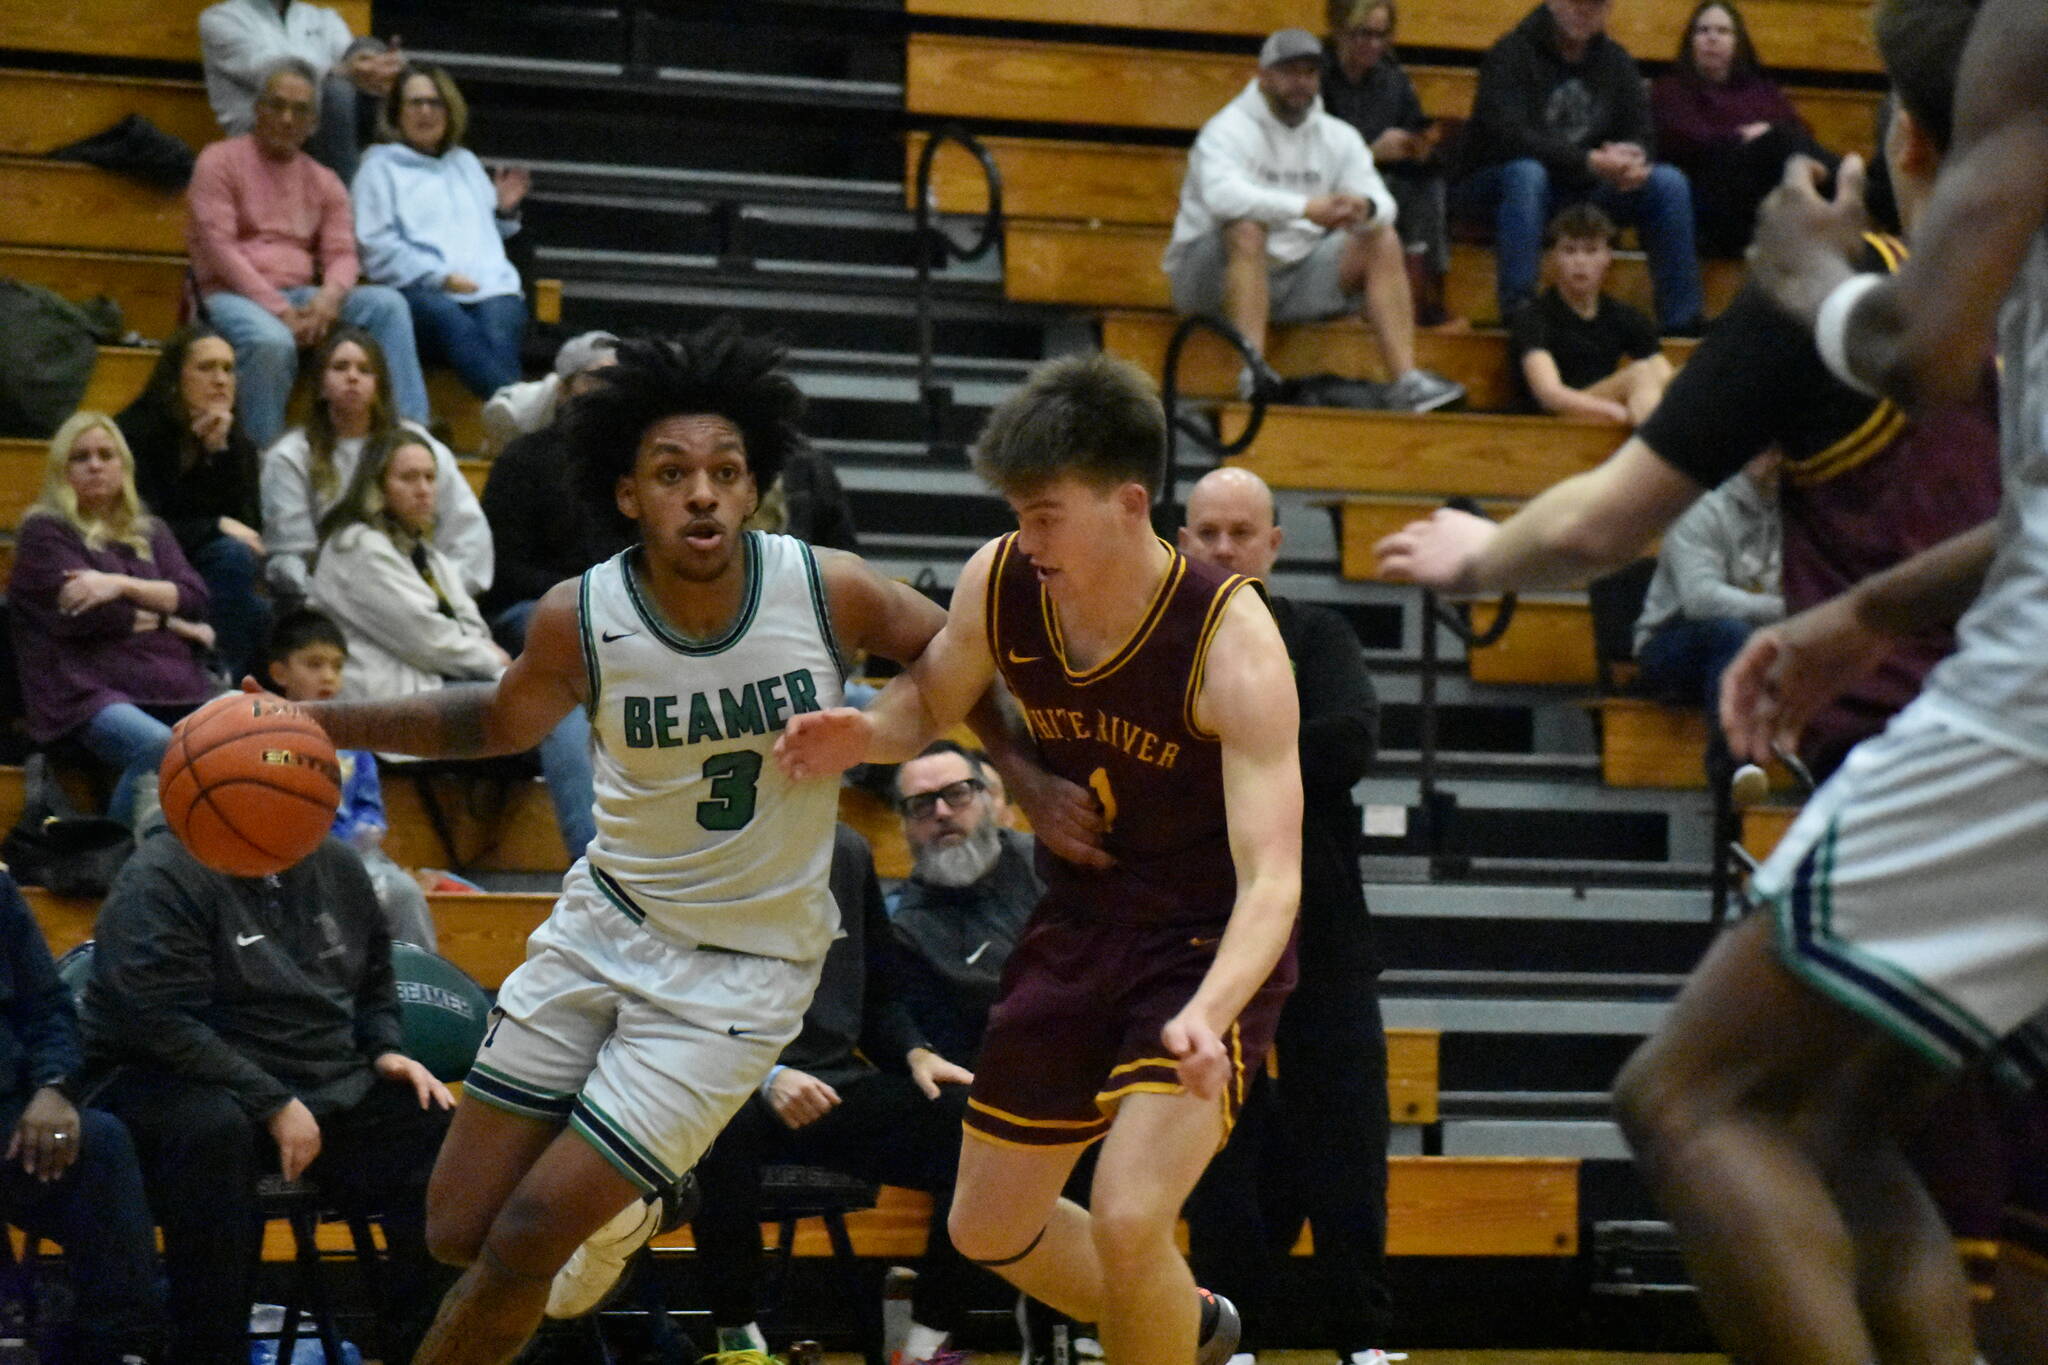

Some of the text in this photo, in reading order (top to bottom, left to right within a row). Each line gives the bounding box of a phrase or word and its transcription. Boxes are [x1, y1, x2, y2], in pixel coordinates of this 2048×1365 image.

[624, 668, 821, 748] BEAMER
[1027, 707, 1090, 742] HIE
[696, 750, 763, 831] 3
